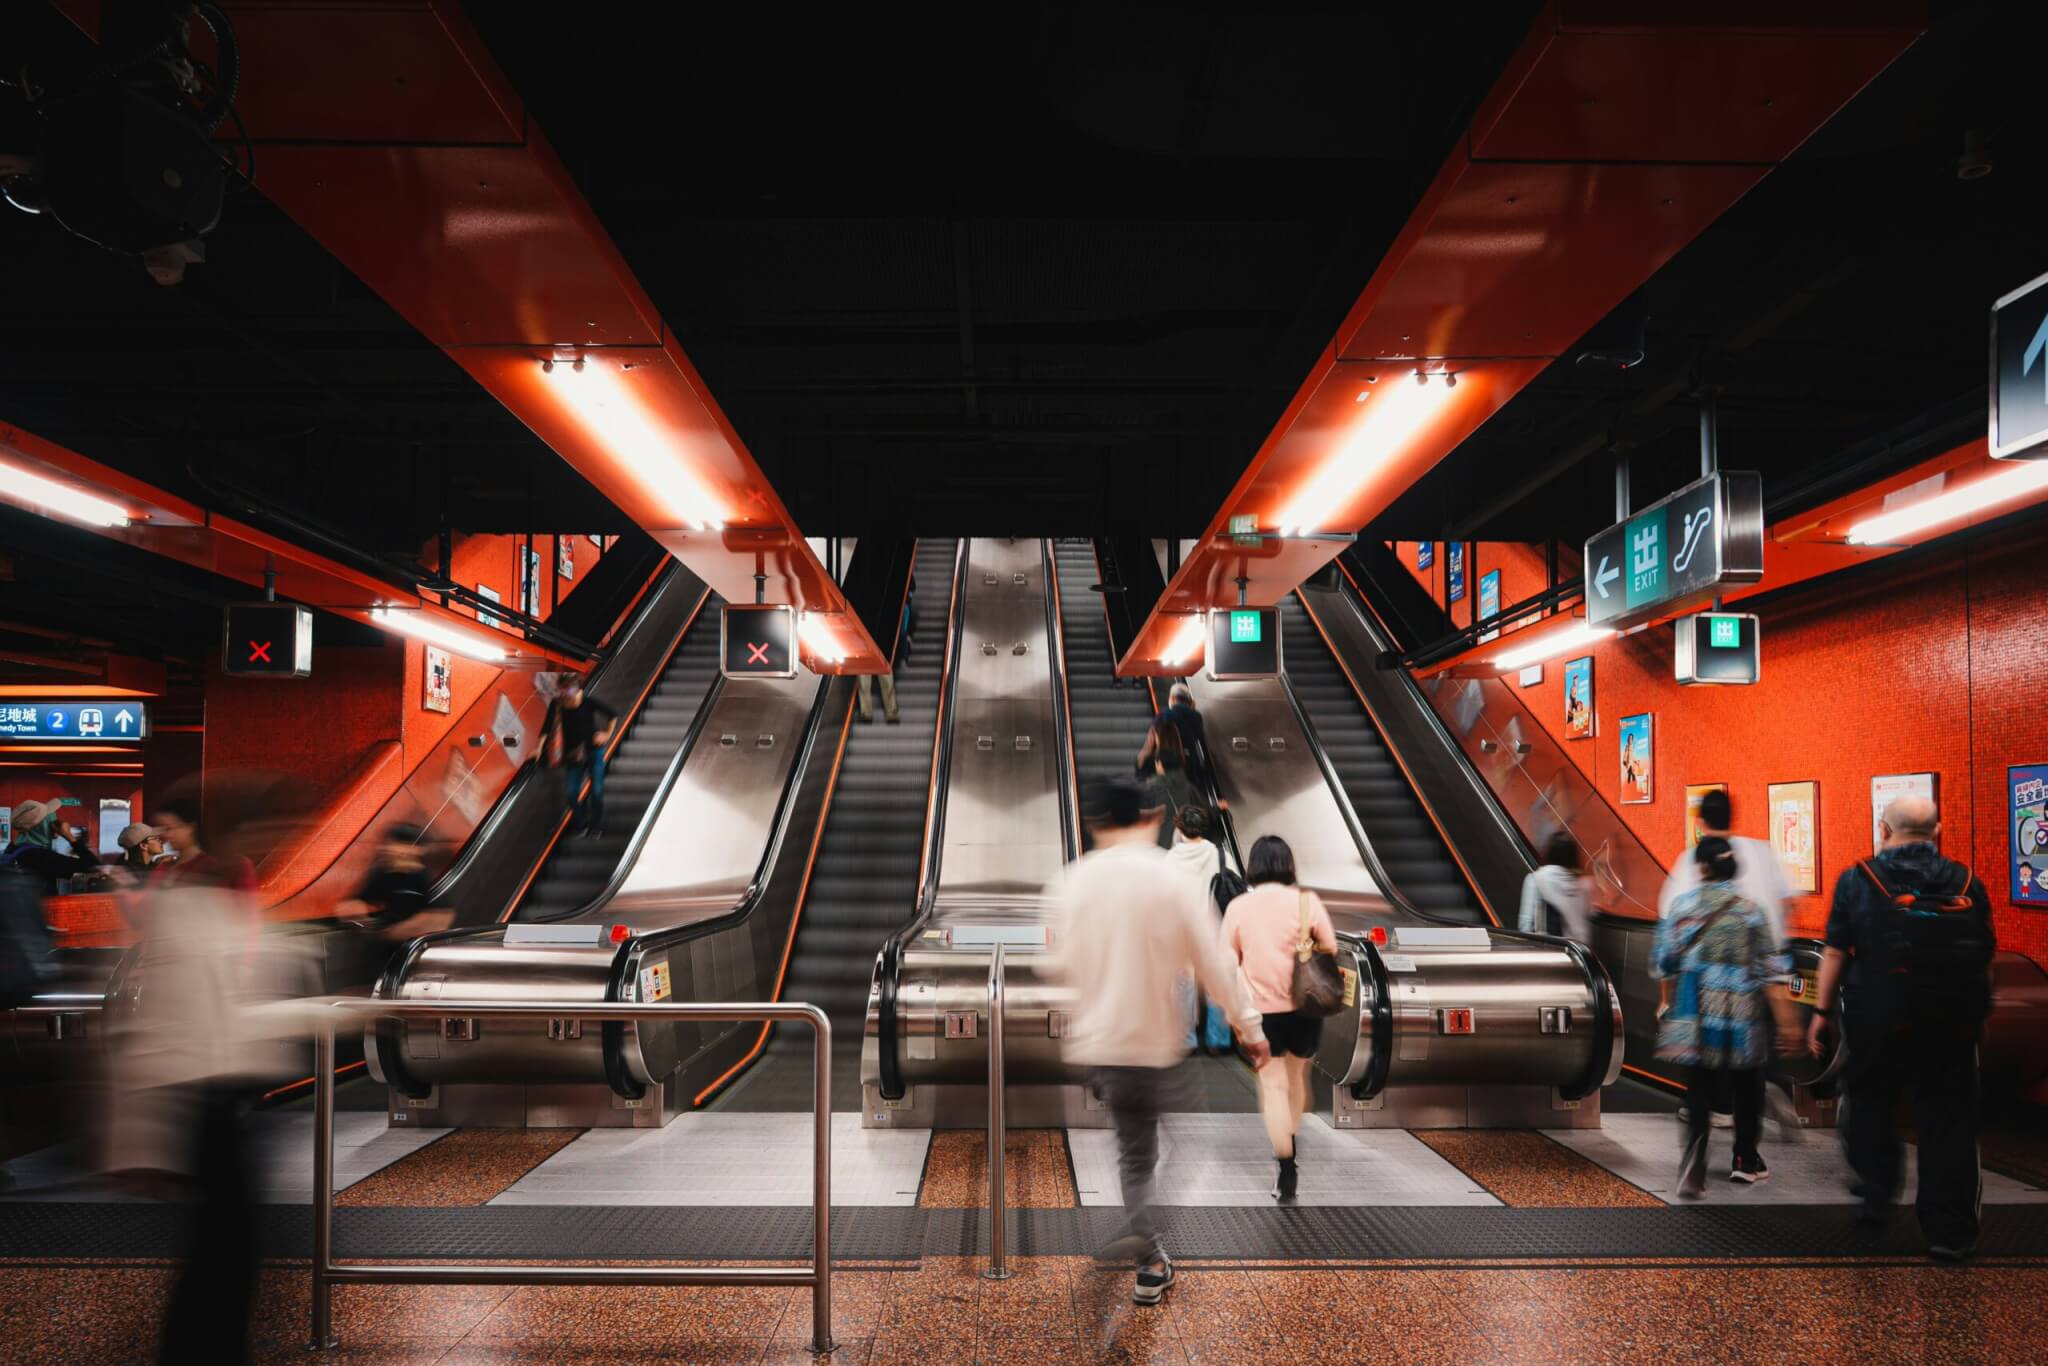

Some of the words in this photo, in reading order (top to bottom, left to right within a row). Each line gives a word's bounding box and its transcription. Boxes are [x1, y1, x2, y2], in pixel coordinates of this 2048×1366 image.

[1634, 524, 1658, 574] 出
[1635, 568, 1658, 592] EXIT
[17, 724, 36, 732] Town
[52, 712, 63, 728] 2
